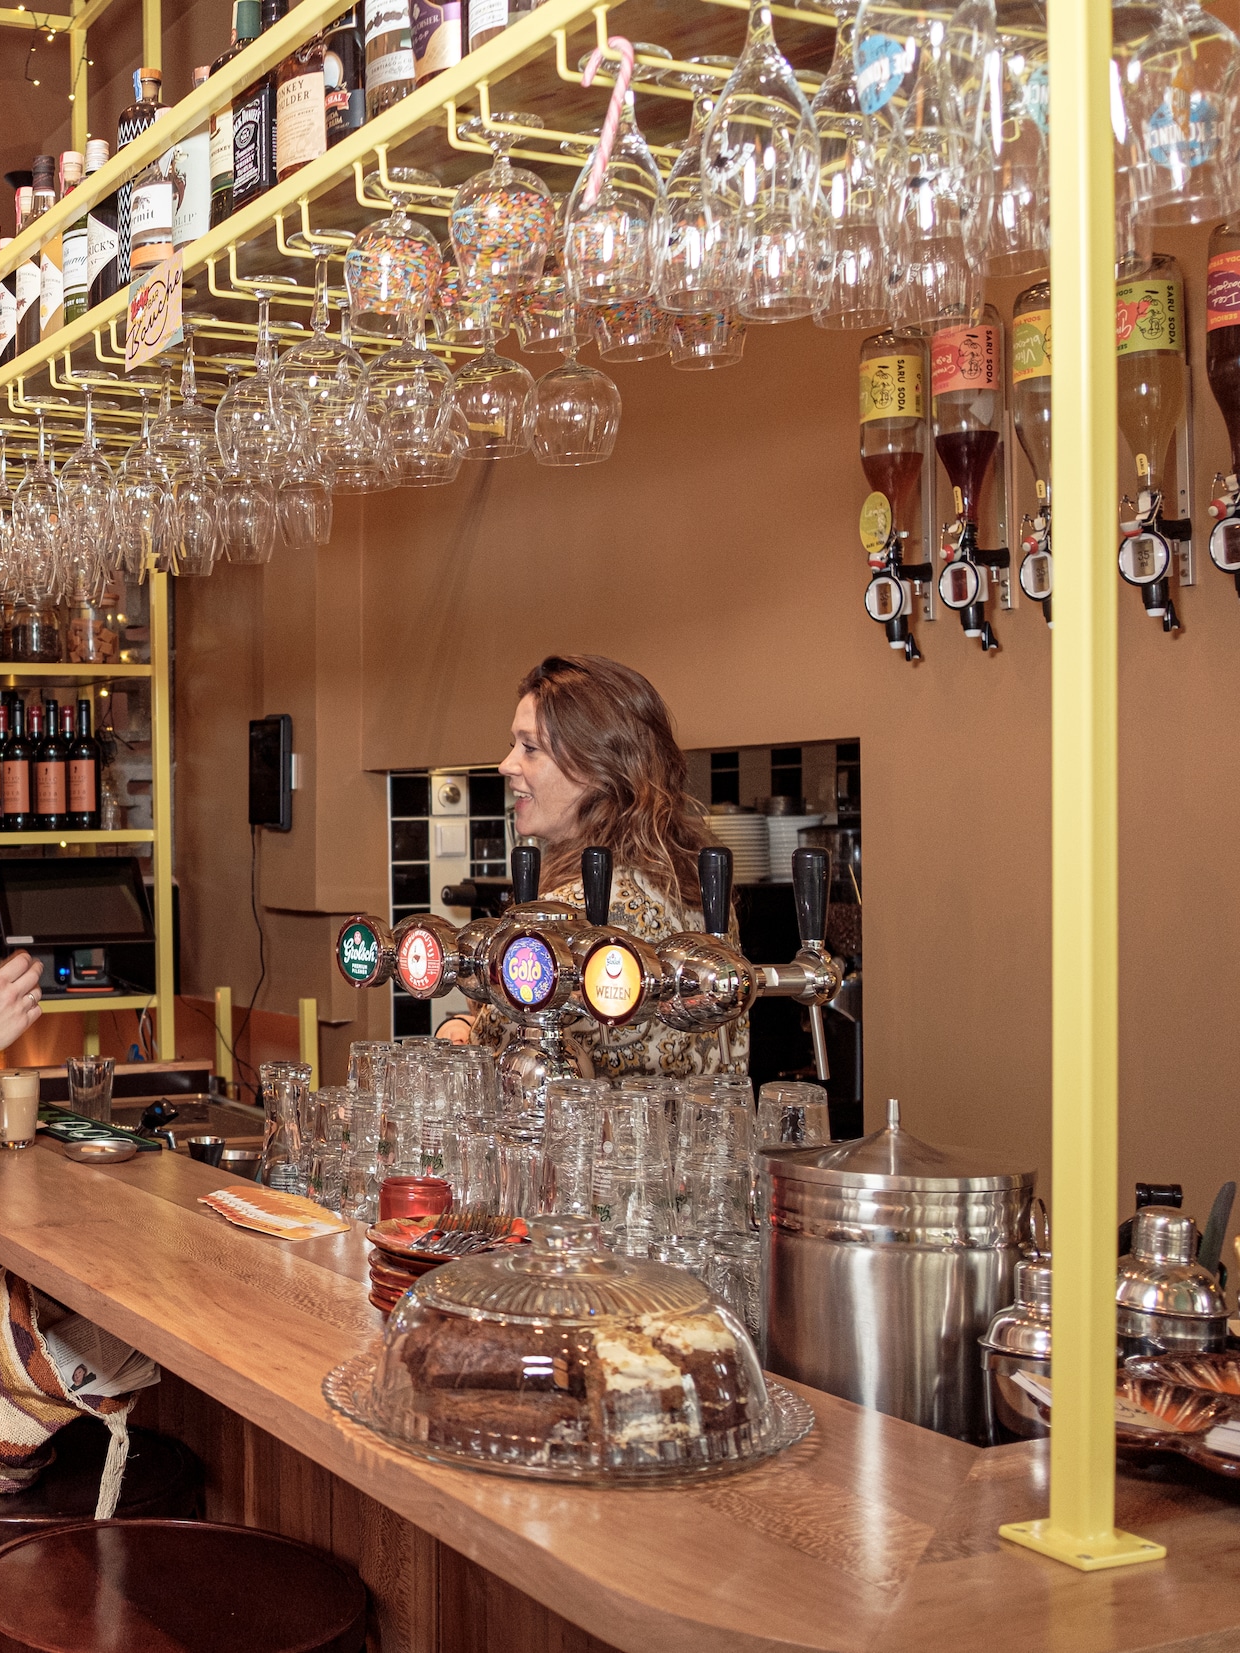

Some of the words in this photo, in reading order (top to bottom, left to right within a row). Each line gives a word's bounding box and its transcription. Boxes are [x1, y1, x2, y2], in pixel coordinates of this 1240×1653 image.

[1167, 285, 1175, 313] SARU
[985, 329, 994, 356] SARU
[1168, 317, 1176, 345] SODA
[897, 359, 905, 383] SARU
[897, 387, 906, 412] SODA
[1137, 550, 1150, 560] 35
[343, 937, 377, 963] Grolsch
[595, 985, 632, 1001] WEIZEN
